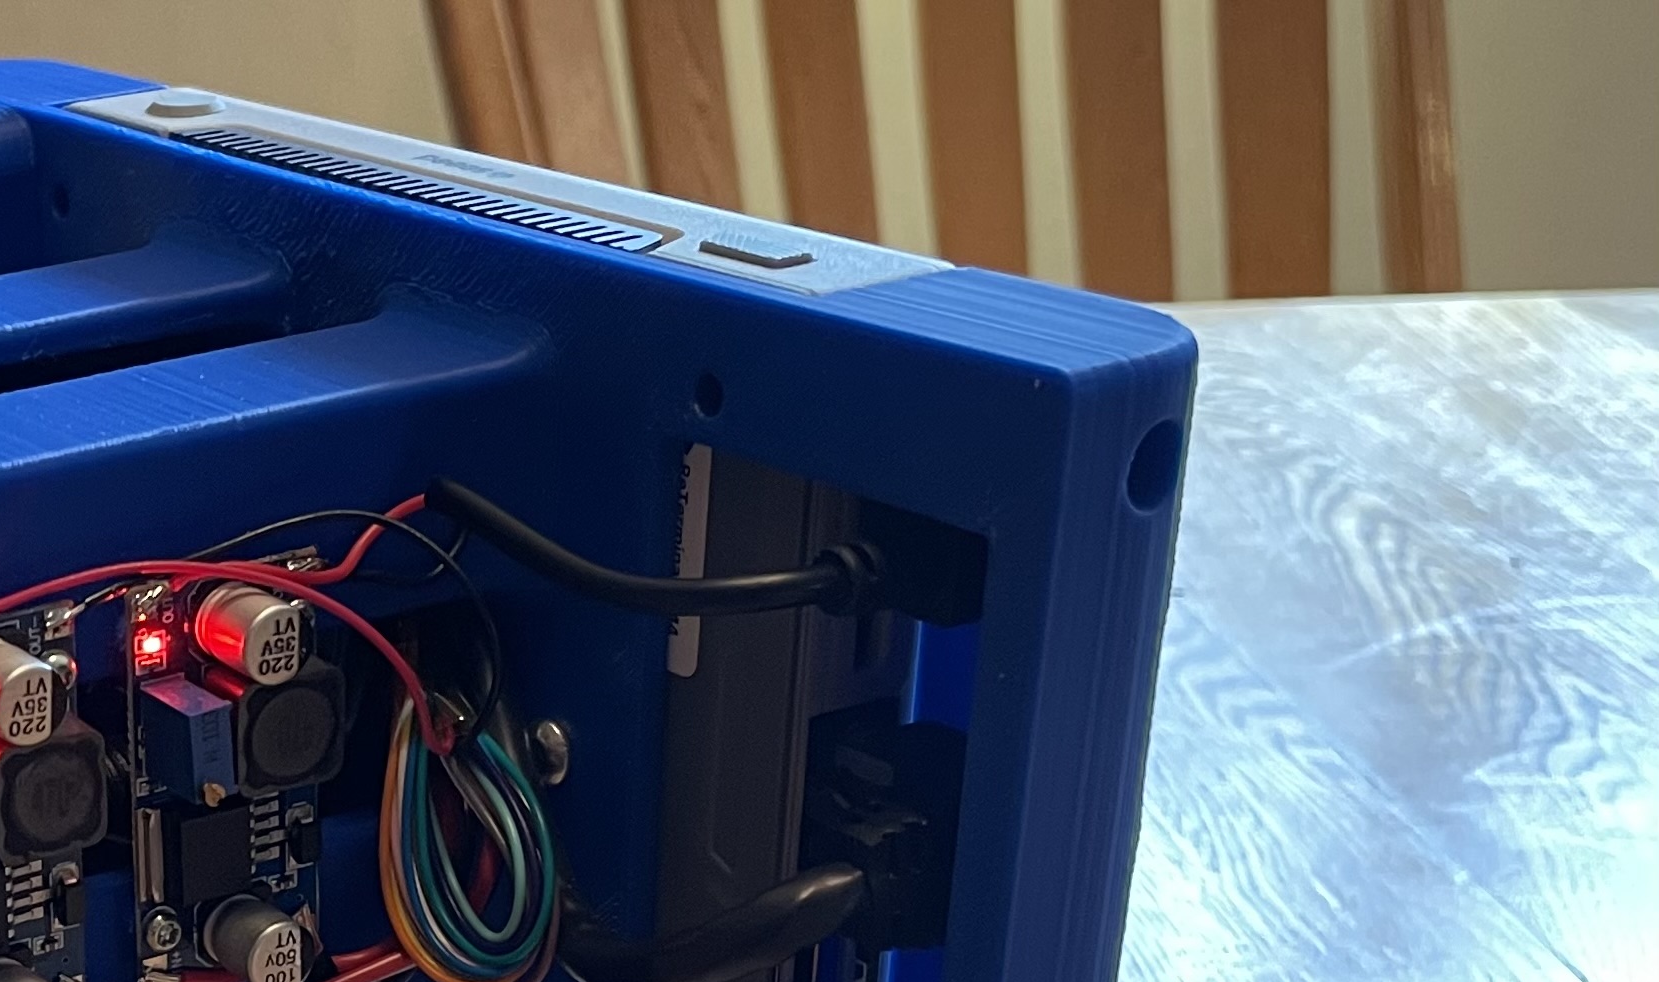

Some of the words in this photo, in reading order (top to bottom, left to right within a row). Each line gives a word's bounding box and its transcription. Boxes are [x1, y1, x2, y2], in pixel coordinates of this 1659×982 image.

[273, 617, 297, 637] VT
[260, 636, 297, 658] 35V
[258, 653, 296, 677] 220
[24, 677, 49, 696] VT
[11, 696, 48, 719] 35V
[9, 715, 47, 738] 220
[275, 929, 297, 950] VT
